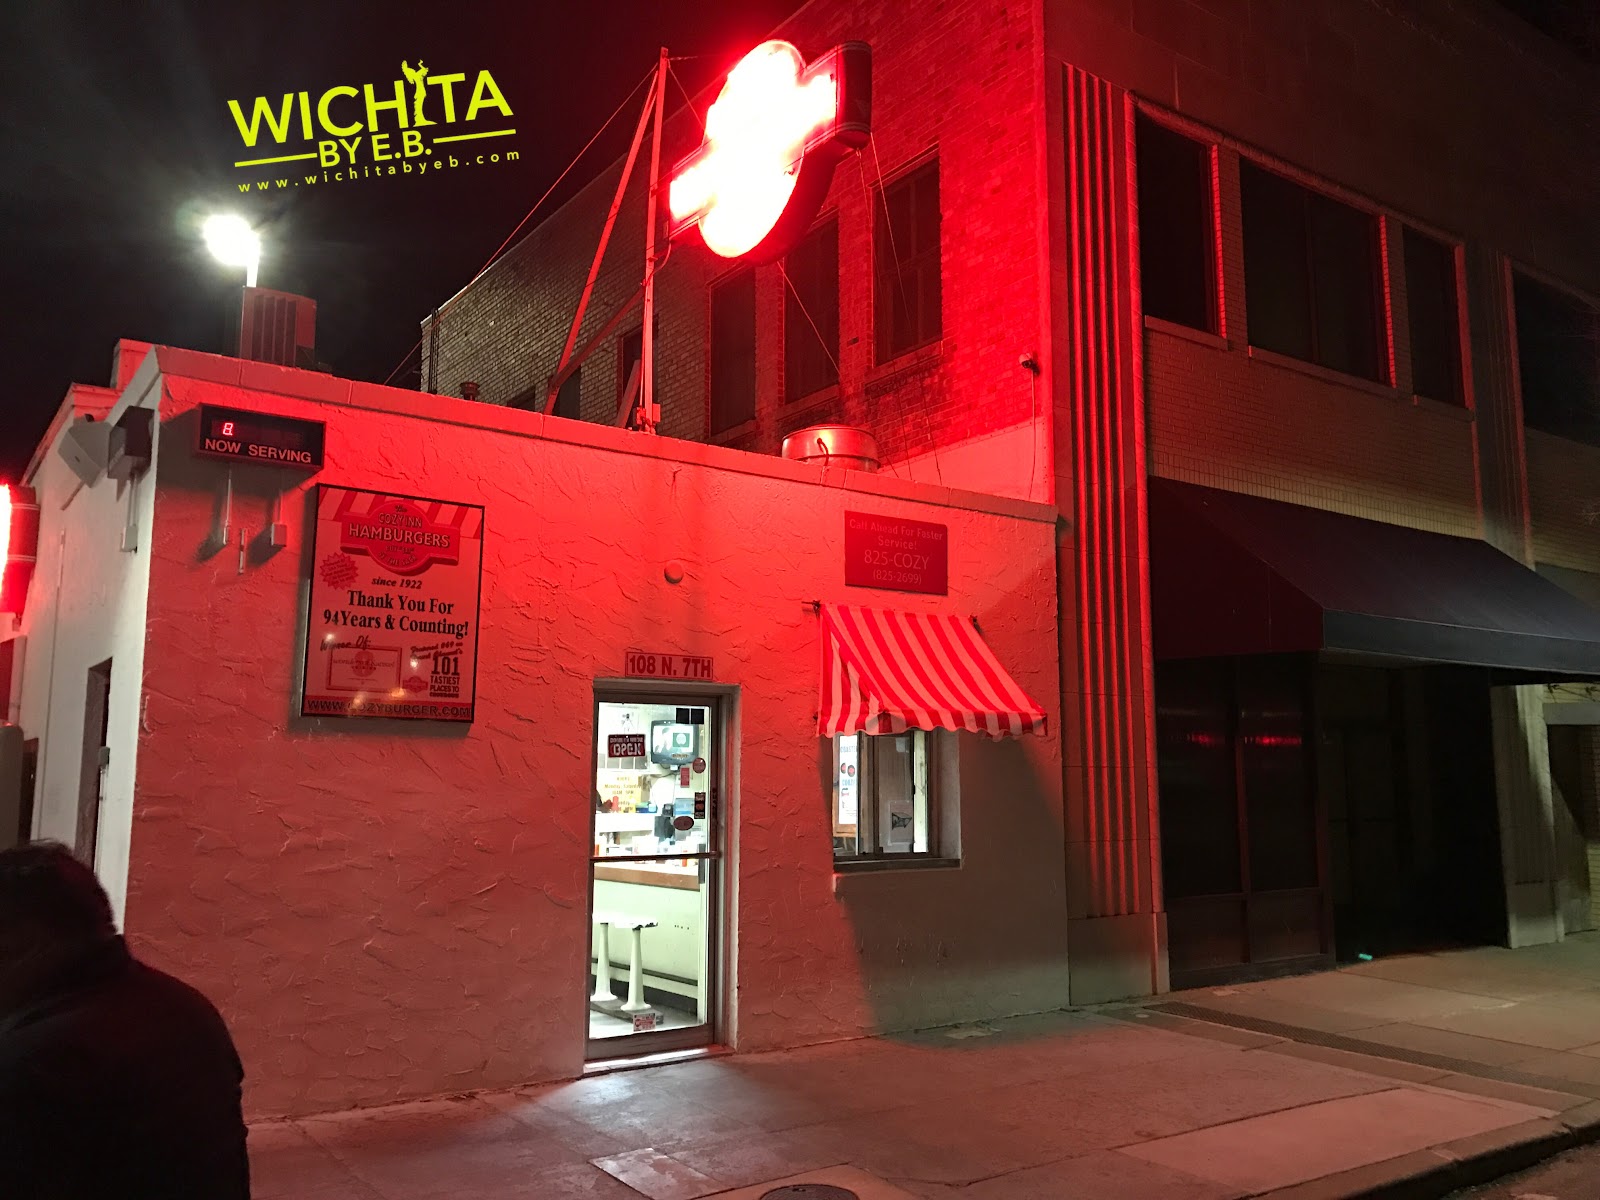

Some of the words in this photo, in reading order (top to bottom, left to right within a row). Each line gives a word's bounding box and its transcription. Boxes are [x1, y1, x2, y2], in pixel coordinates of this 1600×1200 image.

[205, 438, 241, 454] NOW
[248, 444, 312, 463] SERVING
[378, 512, 404, 526] COZY
[405, 515, 423, 528] INN
[849, 518, 868, 530] Call
[870, 522, 898, 535] Ahead
[901, 526, 914, 537] For
[917, 528, 943, 540] Faster
[348, 523, 451, 548] HAMBURGERS
[878, 535, 917, 550] Service!
[864, 549, 930, 570] 825-COZY
[371, 576, 397, 587] since
[399, 579, 423, 589] 1922
[872, 569, 922, 585] (825-2699)
[347, 590, 394, 609] Thank
[398, 595, 425, 612] You
[429, 598, 454, 615] For
[385, 614, 395, 630] &
[399, 615, 469, 640] Counting!
[431, 656, 460, 676] 101
[629, 654, 656, 675] 108
[661, 657, 677, 676] N.
[682, 657, 711, 678] 7TH
[429, 684, 451, 692] PLACES
[452, 685, 460, 693] TO
[430, 675, 460, 685] TASTIEST
[613, 742, 641, 756] OPEN
